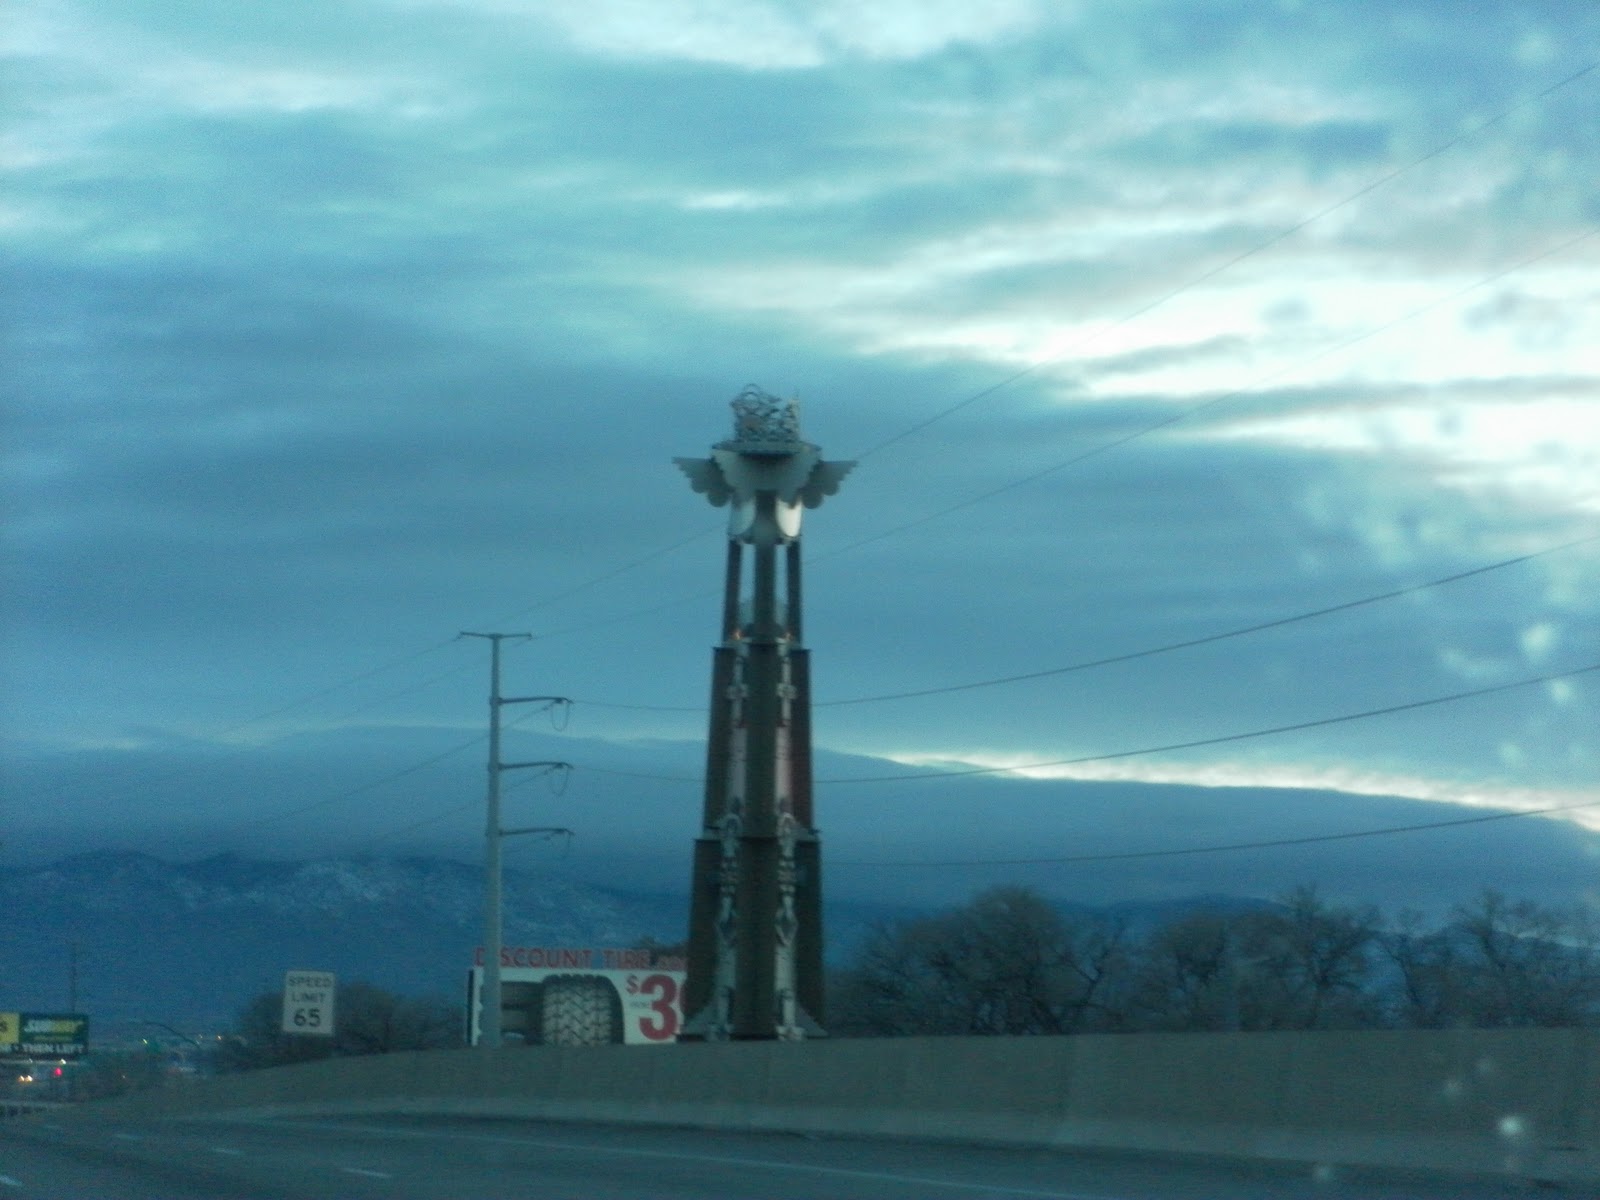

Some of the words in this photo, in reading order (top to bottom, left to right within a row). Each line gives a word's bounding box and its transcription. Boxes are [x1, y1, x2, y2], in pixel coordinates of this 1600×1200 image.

[474, 947, 592, 968] DSCOUNT
[603, 949, 651, 969] TIRE
[288, 975, 332, 988] SPEED
[291, 992, 326, 1003] LIMIT
[293, 1008, 321, 1027] 65
